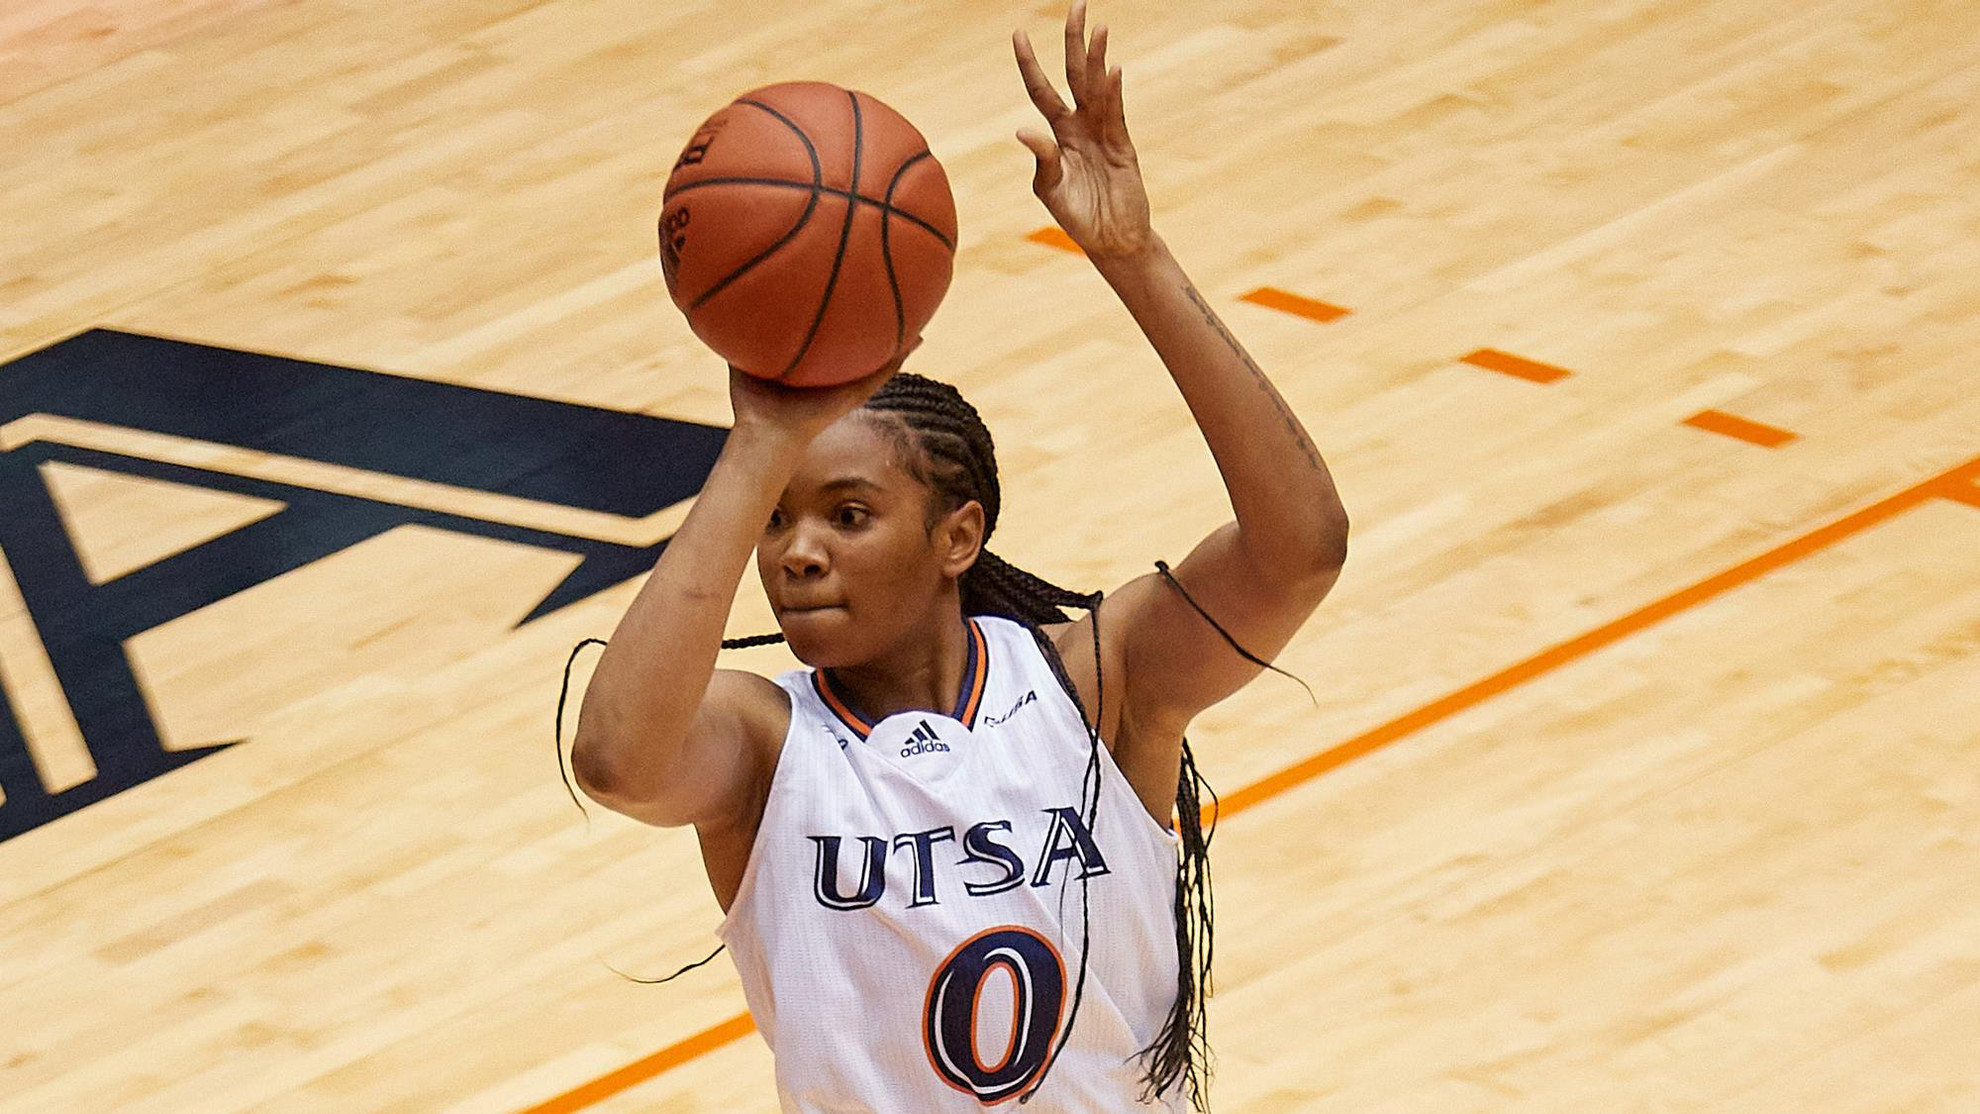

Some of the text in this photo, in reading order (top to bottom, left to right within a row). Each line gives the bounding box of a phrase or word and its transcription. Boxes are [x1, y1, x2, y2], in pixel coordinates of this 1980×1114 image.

[901, 740, 950, 758] adidas
[807, 806, 1110, 910] UTSA
[922, 925, 1068, 1106] 0
